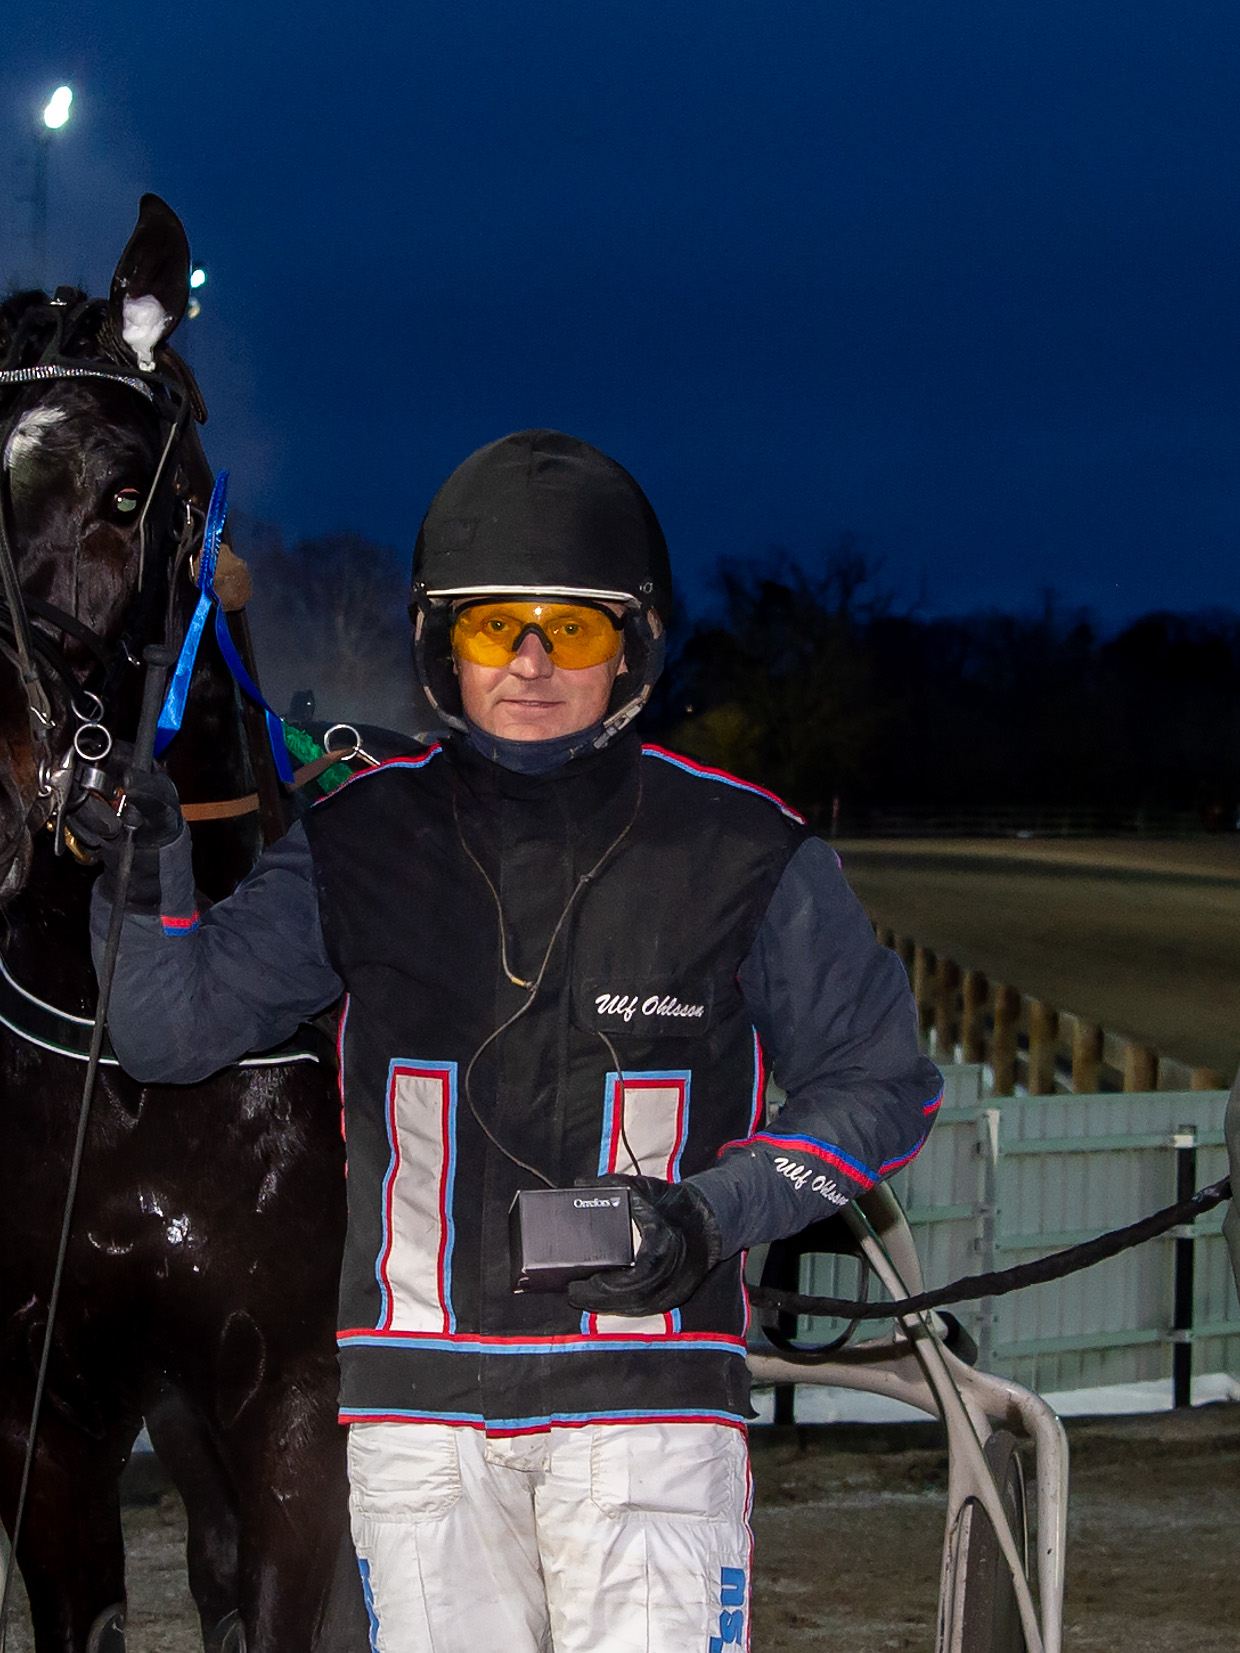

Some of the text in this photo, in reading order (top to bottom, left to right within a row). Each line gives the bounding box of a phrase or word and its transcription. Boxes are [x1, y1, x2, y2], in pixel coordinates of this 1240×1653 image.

[595, 993, 705, 1022] Ulf Ohlsson
[773, 1157, 813, 1190] Ulf
